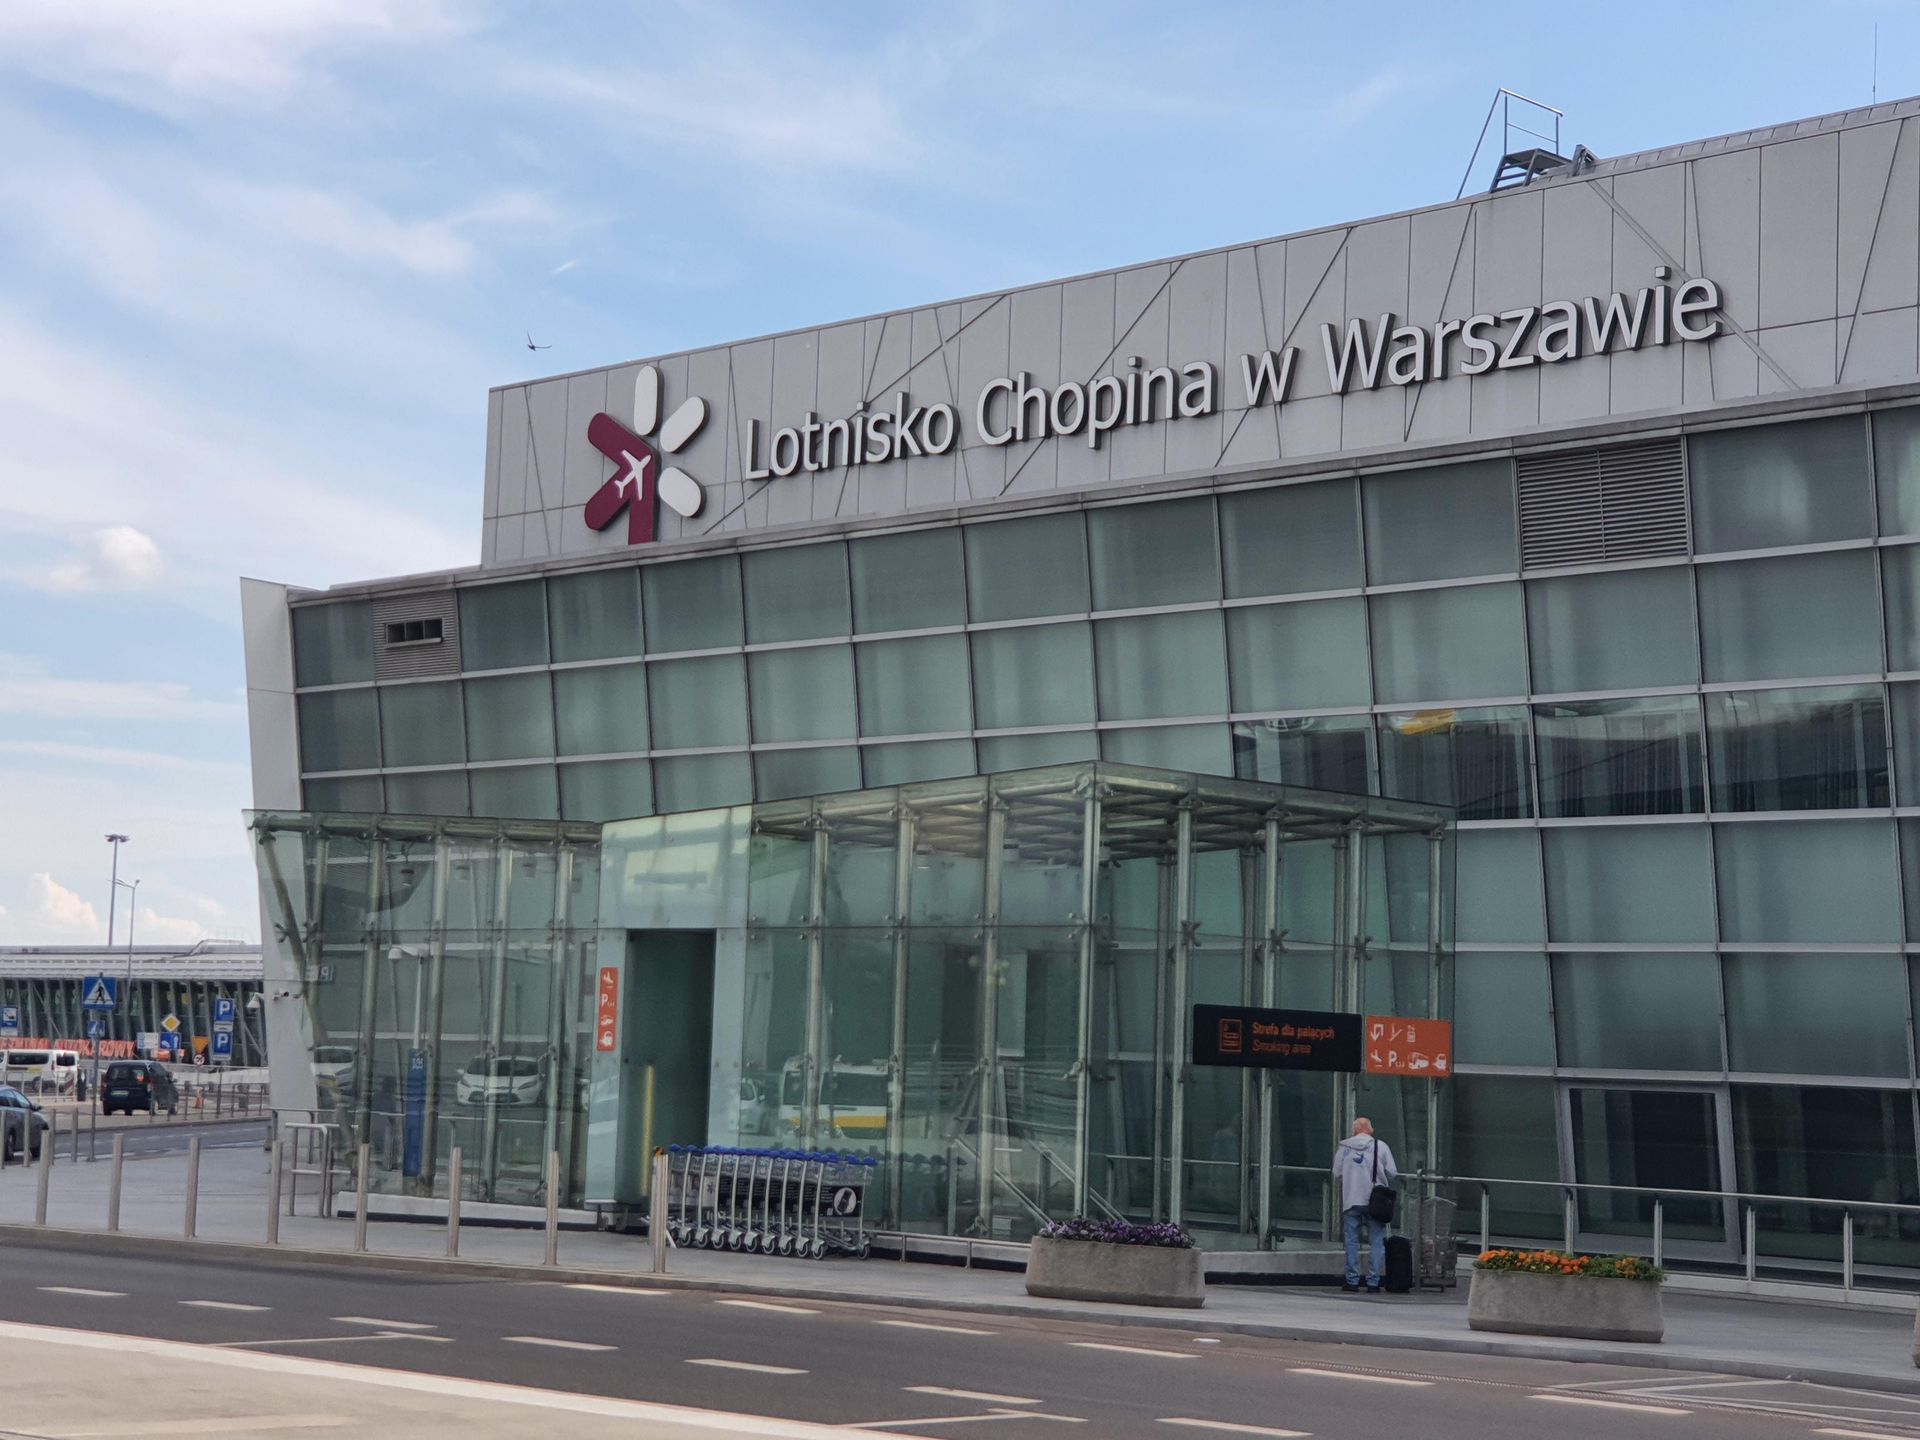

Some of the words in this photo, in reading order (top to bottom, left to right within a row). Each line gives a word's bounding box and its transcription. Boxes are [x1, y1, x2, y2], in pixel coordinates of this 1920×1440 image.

[745, 390, 961, 481] Lotnisko
[976, 356, 1219, 450] Chopina
[1241, 346, 1299, 407] w
[1320, 265, 1724, 394] Warszawie
[219, 1000, 230, 1016] P
[1252, 1022, 1279, 1036] Strefa
[1281, 1023, 1295, 1036] dla
[217, 1033, 229, 1049] P
[1252, 1039, 1290, 1056] Smoking
[1292, 1043, 1312, 1054] area
